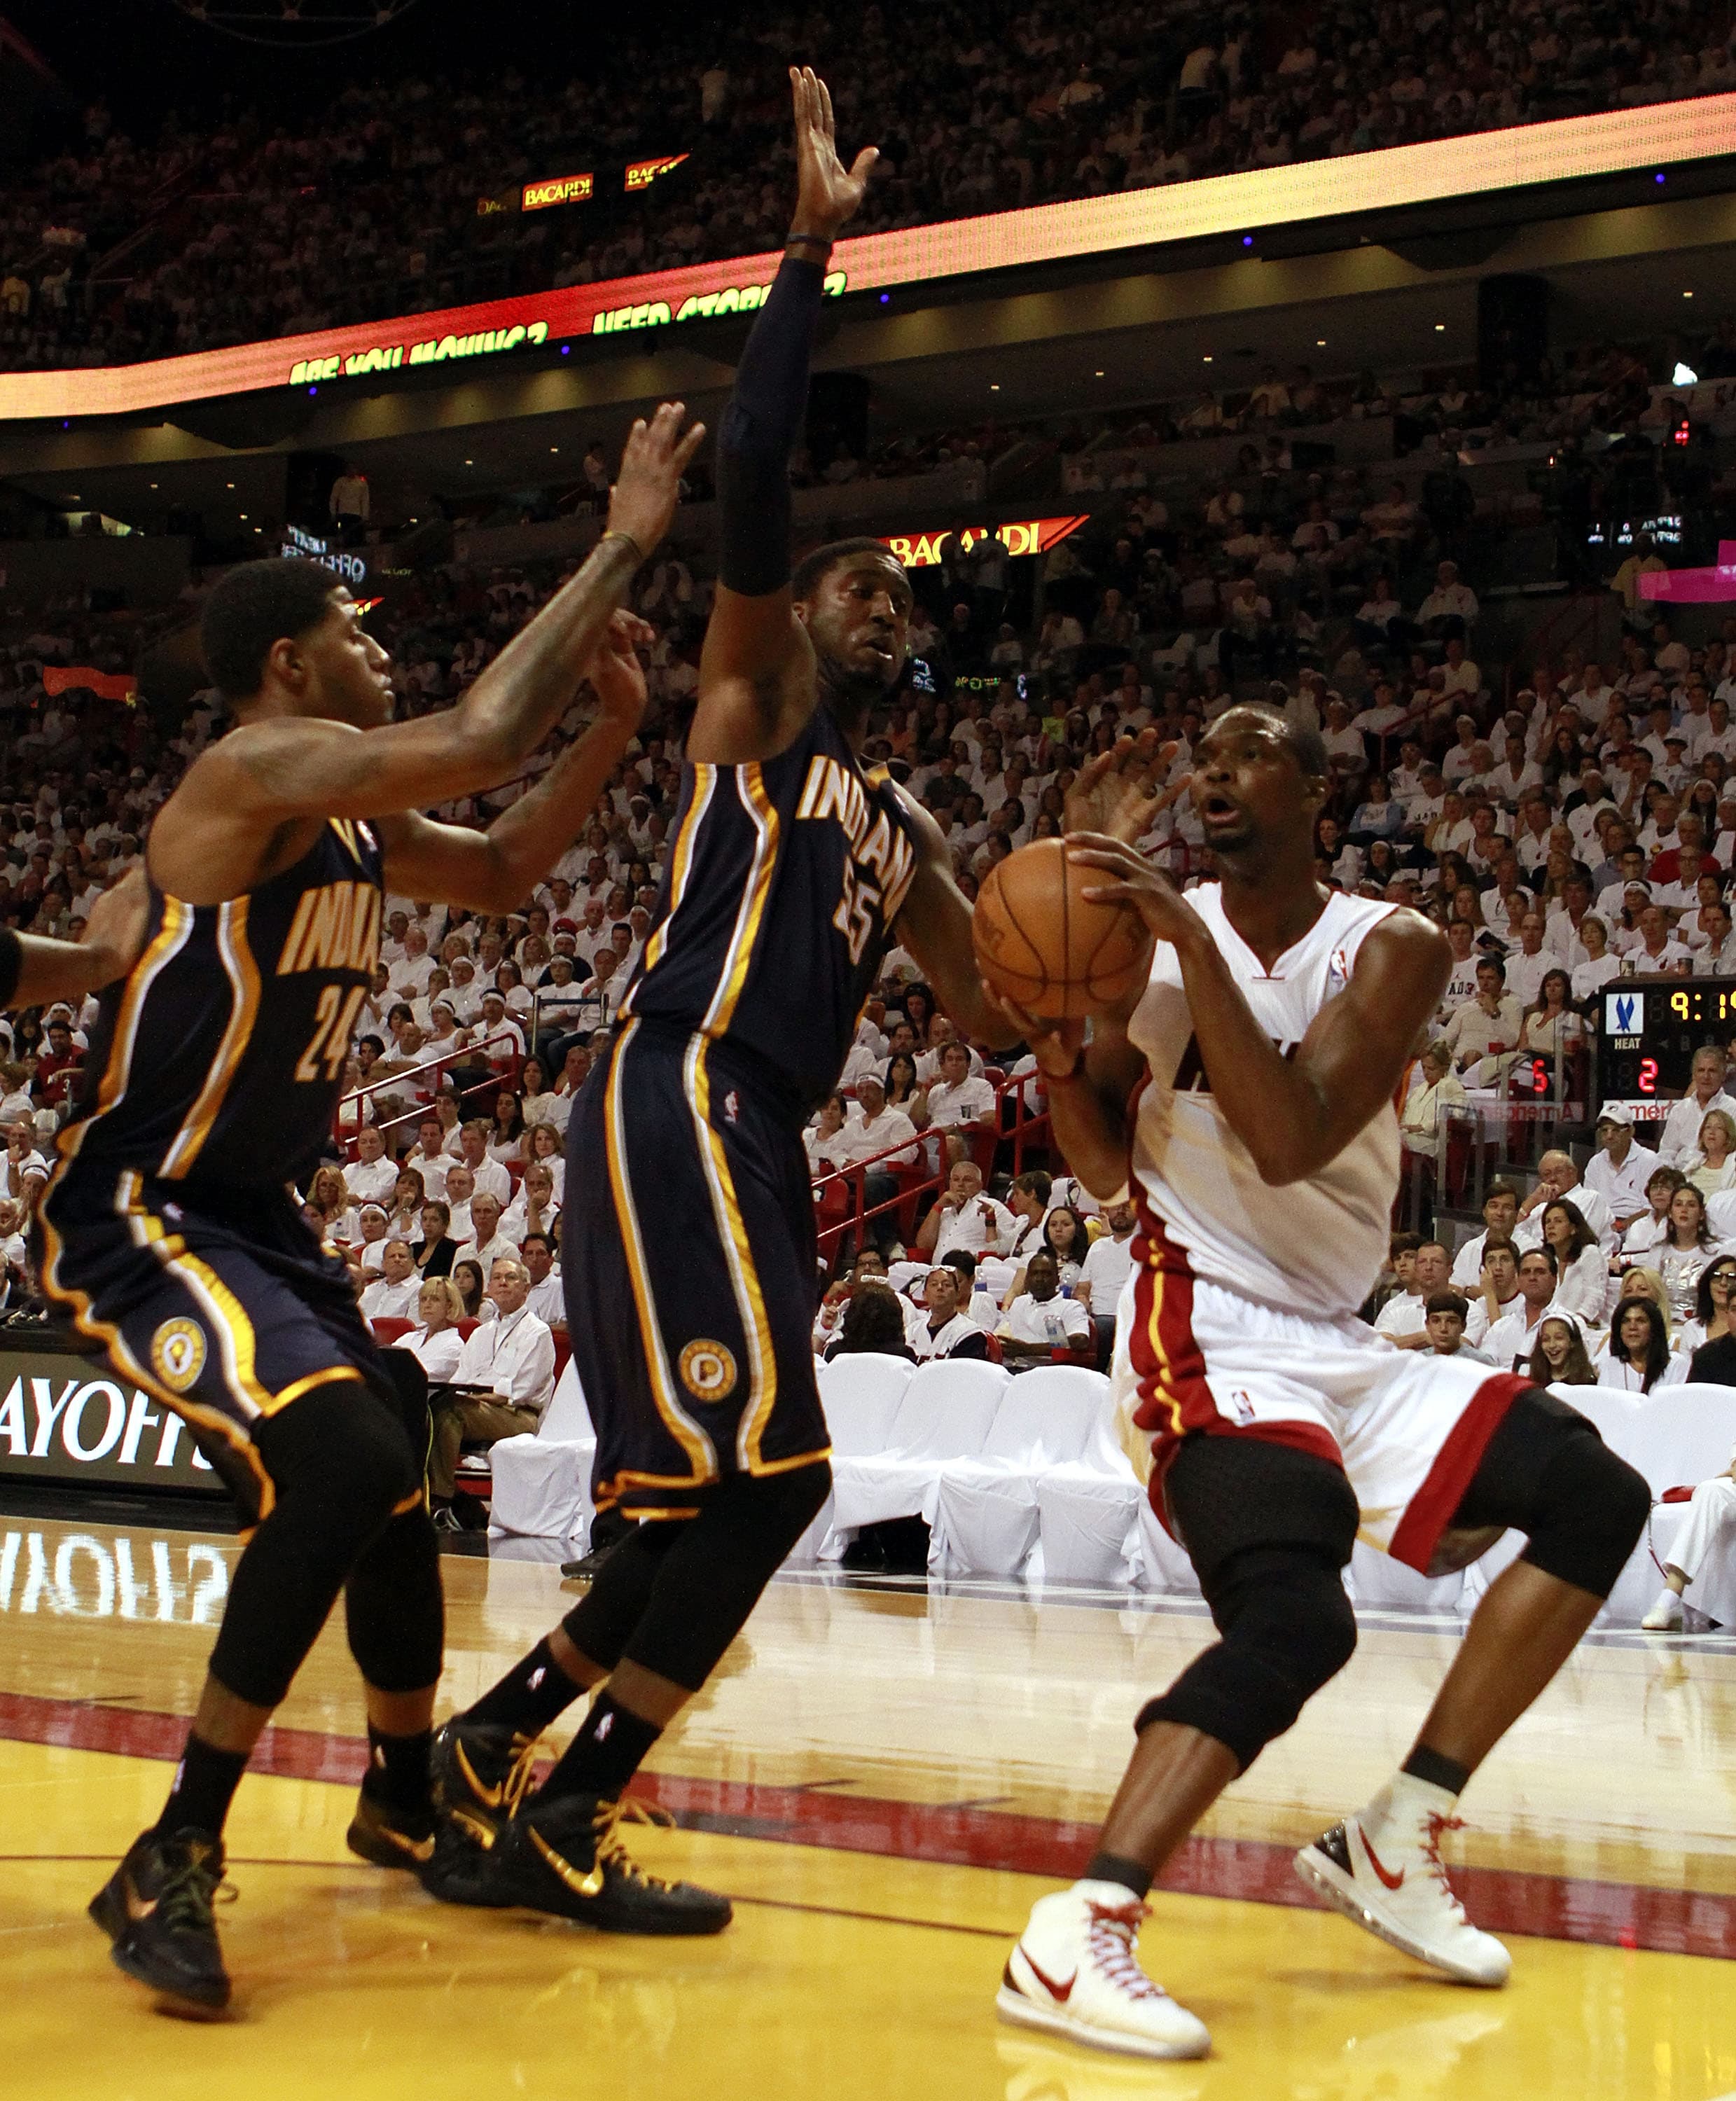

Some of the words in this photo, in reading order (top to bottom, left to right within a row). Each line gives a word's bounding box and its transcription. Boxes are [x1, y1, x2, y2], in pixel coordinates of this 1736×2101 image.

[525, 179, 590, 206] BACARDI
[294, 985, 367, 1082] 24
[1614, 1037, 1641, 1049] HEAT
[1638, 1058, 1659, 1093] 2
